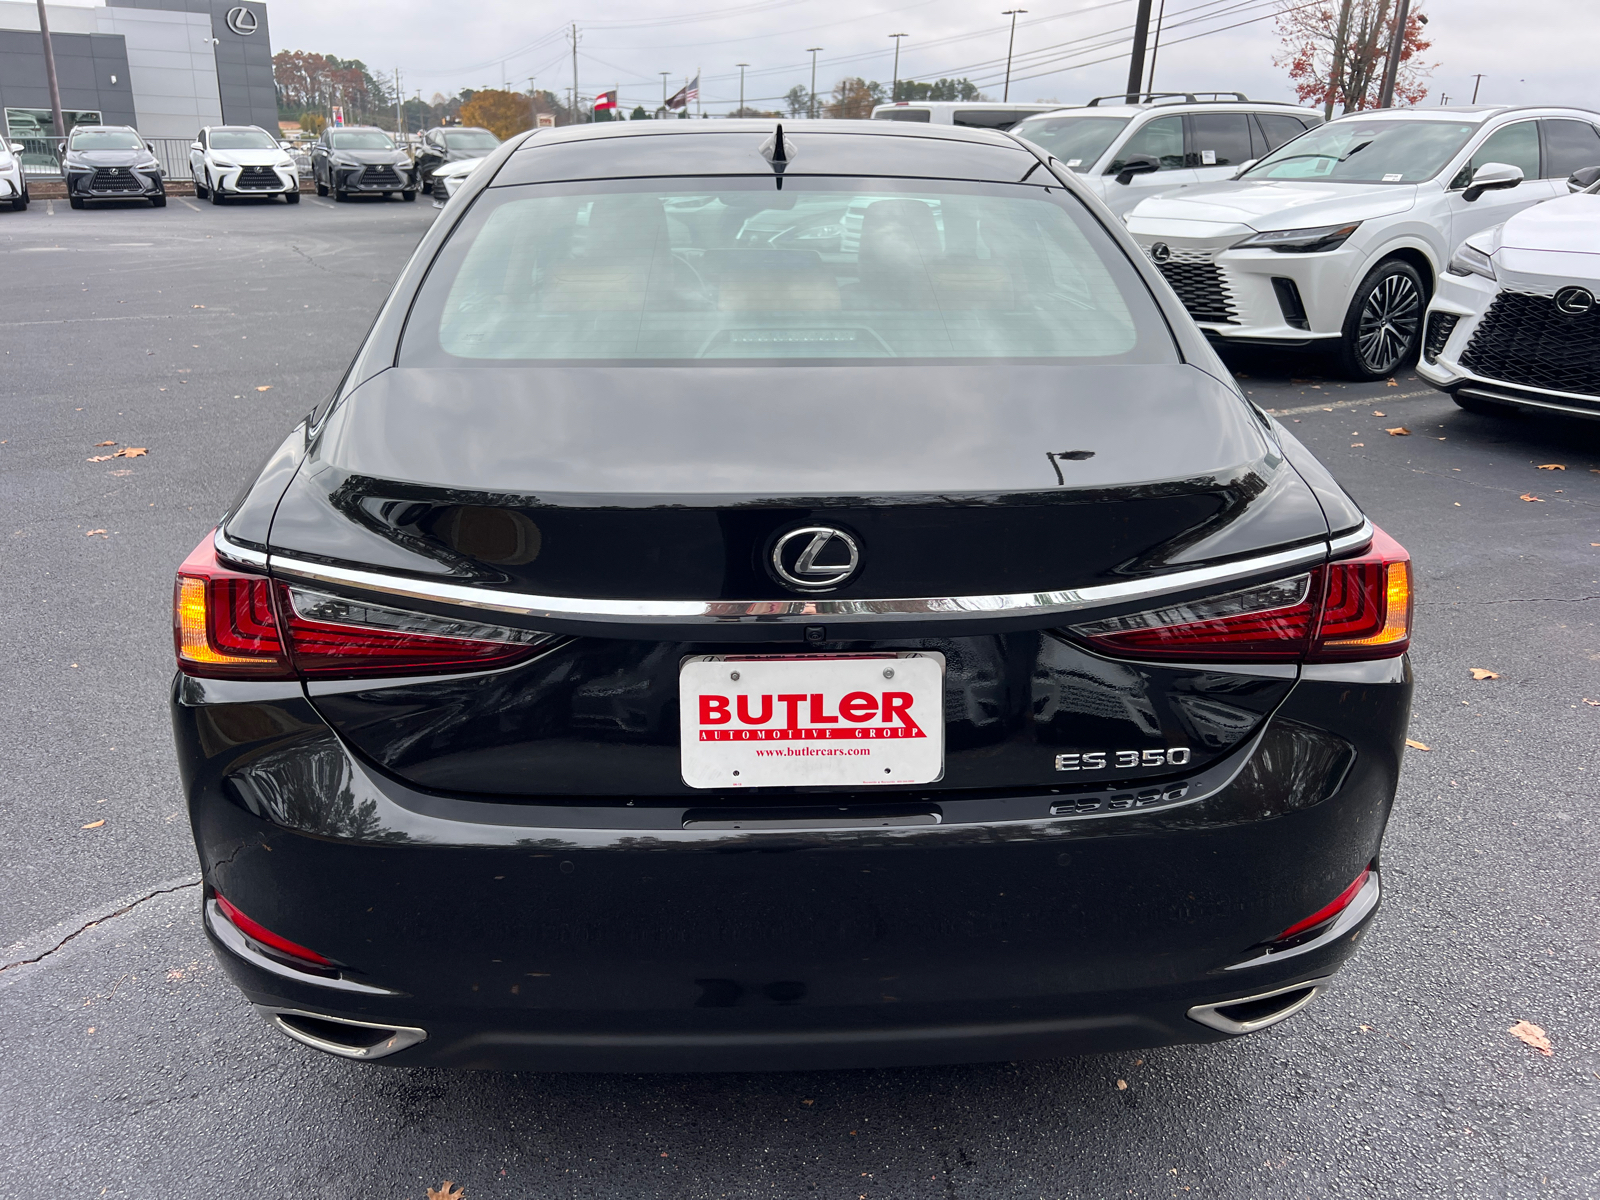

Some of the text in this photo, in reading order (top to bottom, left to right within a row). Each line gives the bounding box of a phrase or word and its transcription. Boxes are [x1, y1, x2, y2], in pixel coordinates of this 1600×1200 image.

[701, 727, 919, 739] AUTOMOTIVE GROUP
[756, 746, 871, 757] www.butlercars.com
[1055, 748, 1191, 771] ES 350
